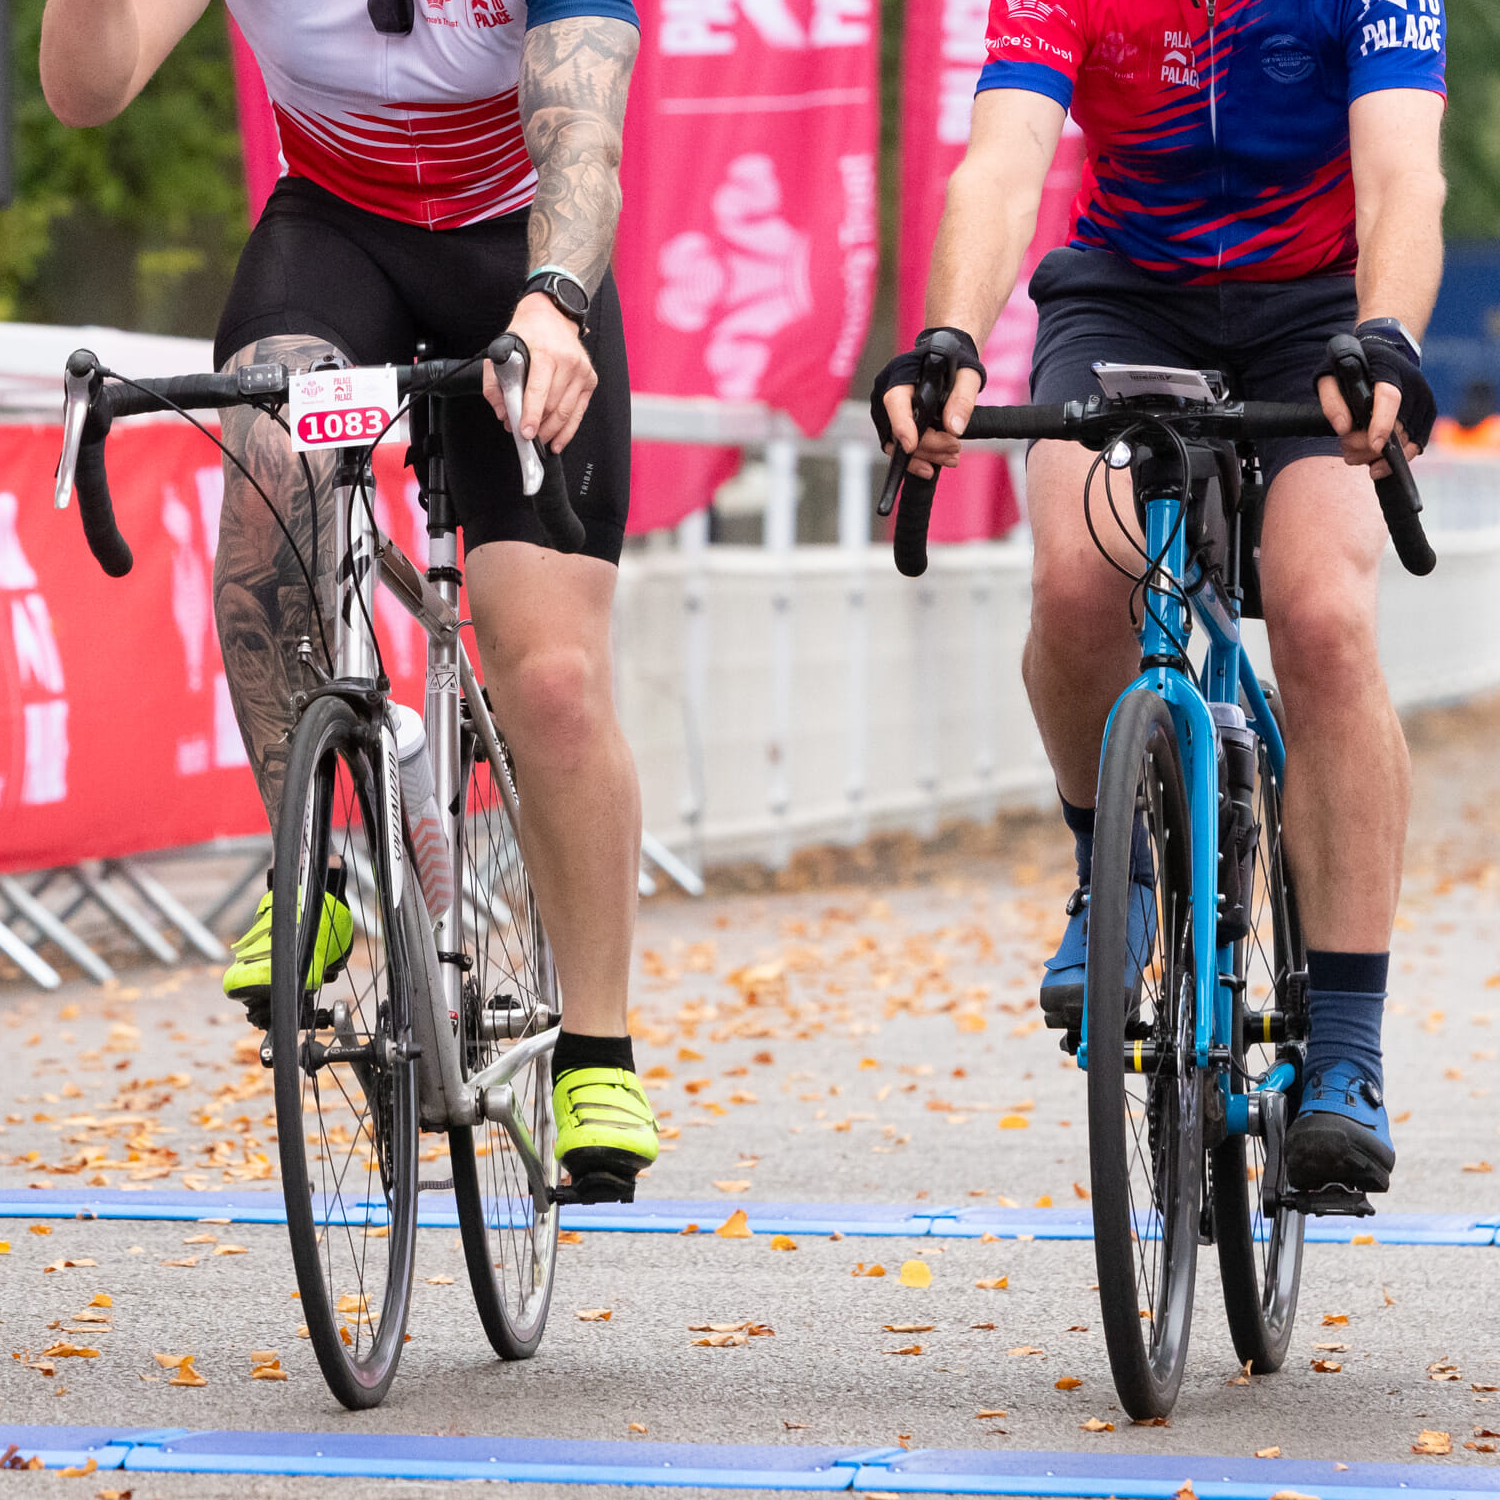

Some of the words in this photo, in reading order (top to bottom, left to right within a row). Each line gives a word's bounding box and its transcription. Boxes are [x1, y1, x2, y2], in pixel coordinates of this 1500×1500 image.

[1164, 30, 1192, 48] PALA
[1360, 14, 1441, 57] PALACE
[1161, 65, 1200, 89] PALAC
[305, 410, 384, 440] 1083
[580, 463, 594, 495] TRIBAN
[388, 751, 402, 862] SPECIALIZED
